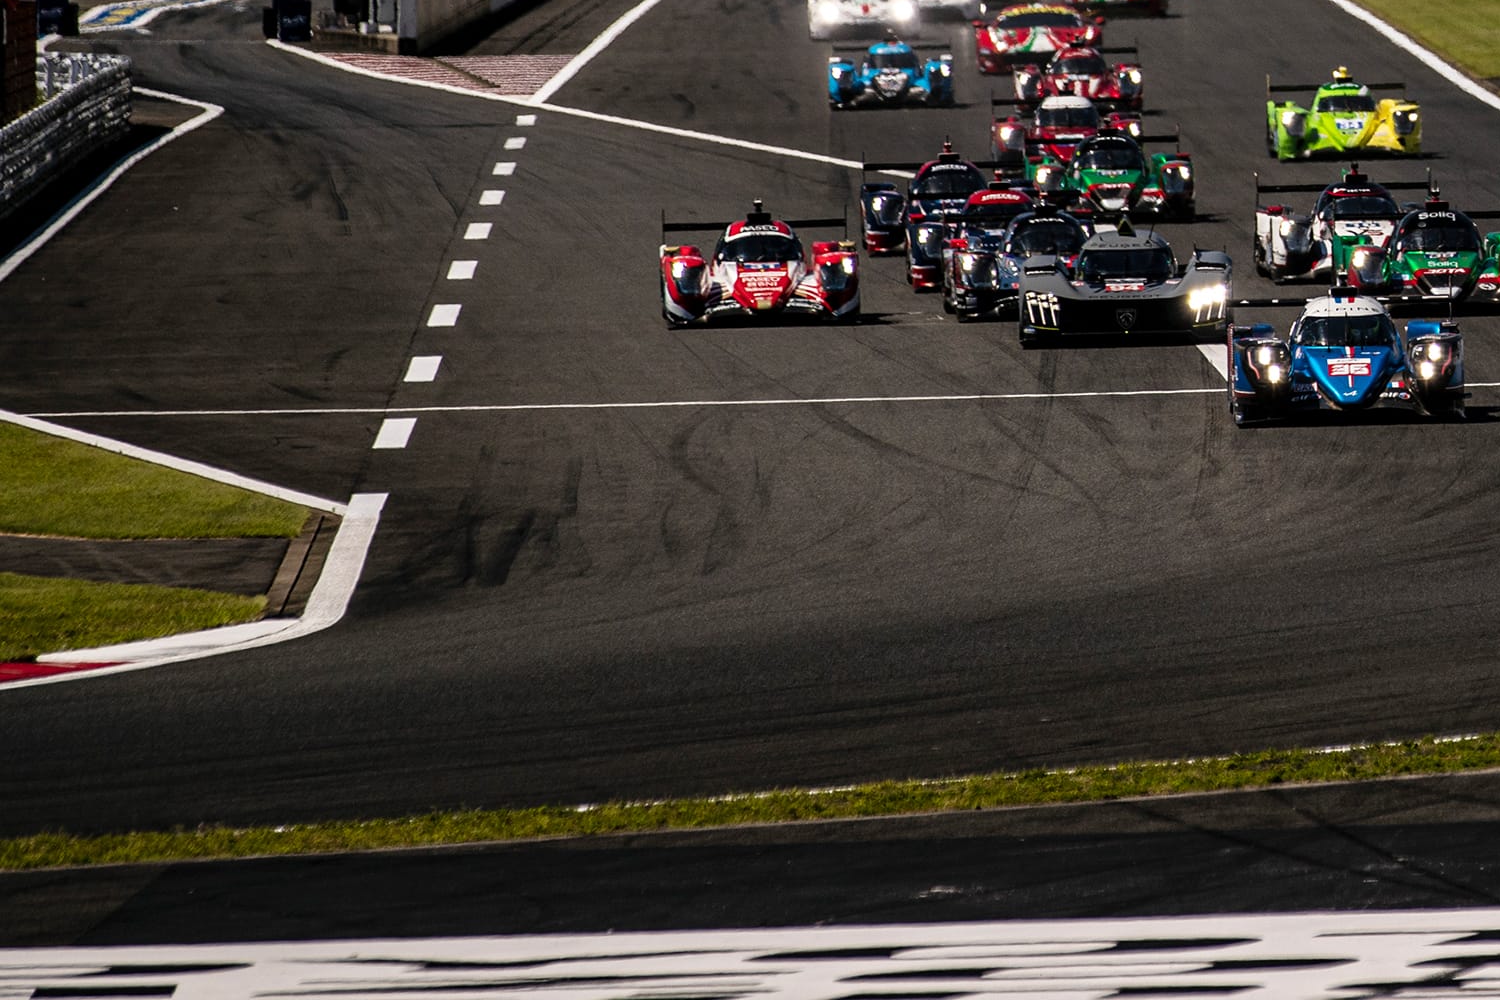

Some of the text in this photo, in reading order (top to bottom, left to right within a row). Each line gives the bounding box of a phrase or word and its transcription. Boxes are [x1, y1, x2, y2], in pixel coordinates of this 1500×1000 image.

[1418, 211, 1457, 222] Soliq
[1427, 260, 1459, 269] Soliq
[1330, 363, 1370, 376] 36
